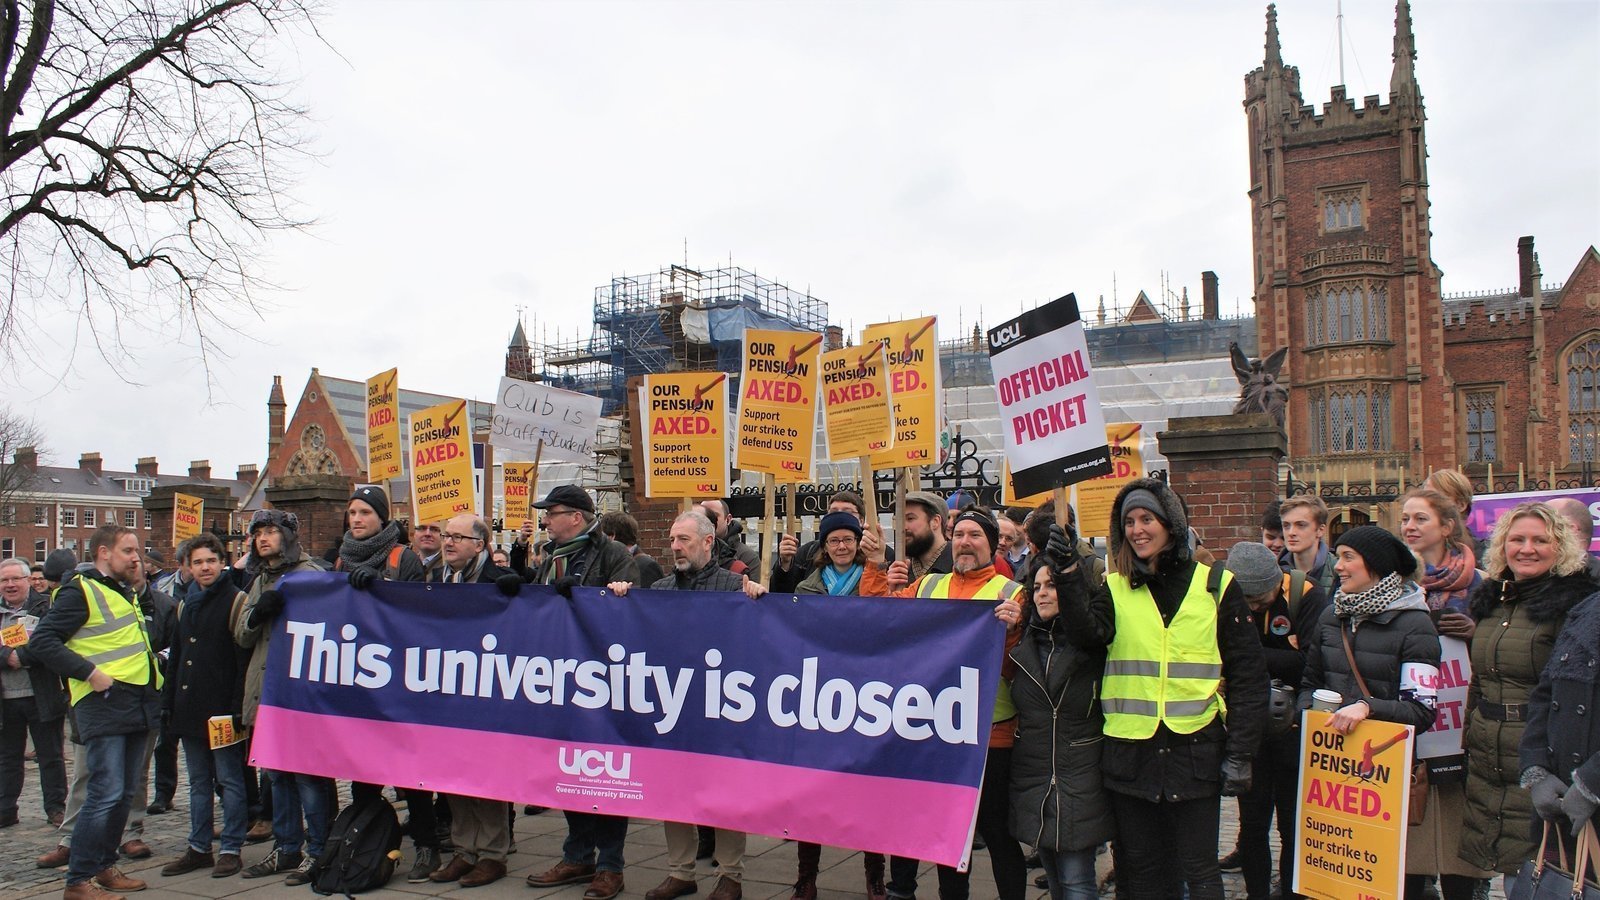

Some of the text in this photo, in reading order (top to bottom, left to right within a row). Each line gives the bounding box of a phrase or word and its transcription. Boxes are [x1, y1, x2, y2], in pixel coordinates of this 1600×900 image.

[750, 342, 775, 356] OUR
[749, 358, 808, 376] PENSION
[824, 359, 846, 372] OUR
[824, 367, 876, 384] PENSION
[999, 350, 1089, 406] OFFICIAL
[369, 384, 378, 396] OUR
[653, 385, 680, 396] OUR
[746, 379, 808, 404] AXED.
[828, 382, 881, 406] AXED.
[369, 392, 393, 408] PENSION
[504, 384, 582, 424] Qub is
[653, 399, 714, 410] PENSION
[370, 408, 395, 428] AXED.
[744, 408, 780, 421] Support
[910, 416, 919, 426] to
[1012, 394, 1086, 446] PICKET
[414, 418, 432, 432] OUR
[494, 414, 538, 437] Staff
[653, 416, 717, 435] AXED.
[742, 424, 798, 437] our strike to
[370, 433, 384, 443] Support
[414, 426, 460, 445] PENSION
[742, 436, 793, 451] defend USS
[898, 430, 916, 441] USS
[416, 442, 464, 467] AXED.
[654, 443, 691, 453] Support
[370, 452, 392, 464] defend USS
[671, 455, 698, 464] strike
[1064, 457, 1106, 474] www.ucu.org.uk
[416, 470, 444, 482] Support
[654, 467, 686, 476] defend
[418, 477, 460, 493] our strike to
[418, 489, 459, 505] defend USS
[177, 513, 198, 525] AXED.
[6, 636, 25, 644] AXED.
[286, 620, 979, 745] This university is closed
[1312, 730, 1344, 752] OUR
[1310, 751, 1390, 784] PENSION
[556, 786, 643, 800] Queen's University Branch
[1306, 778, 1390, 821] AXED.
[1306, 816, 1353, 839] Support
[1306, 836, 1377, 864] our strike to
[1306, 853, 1373, 882] defend USS
